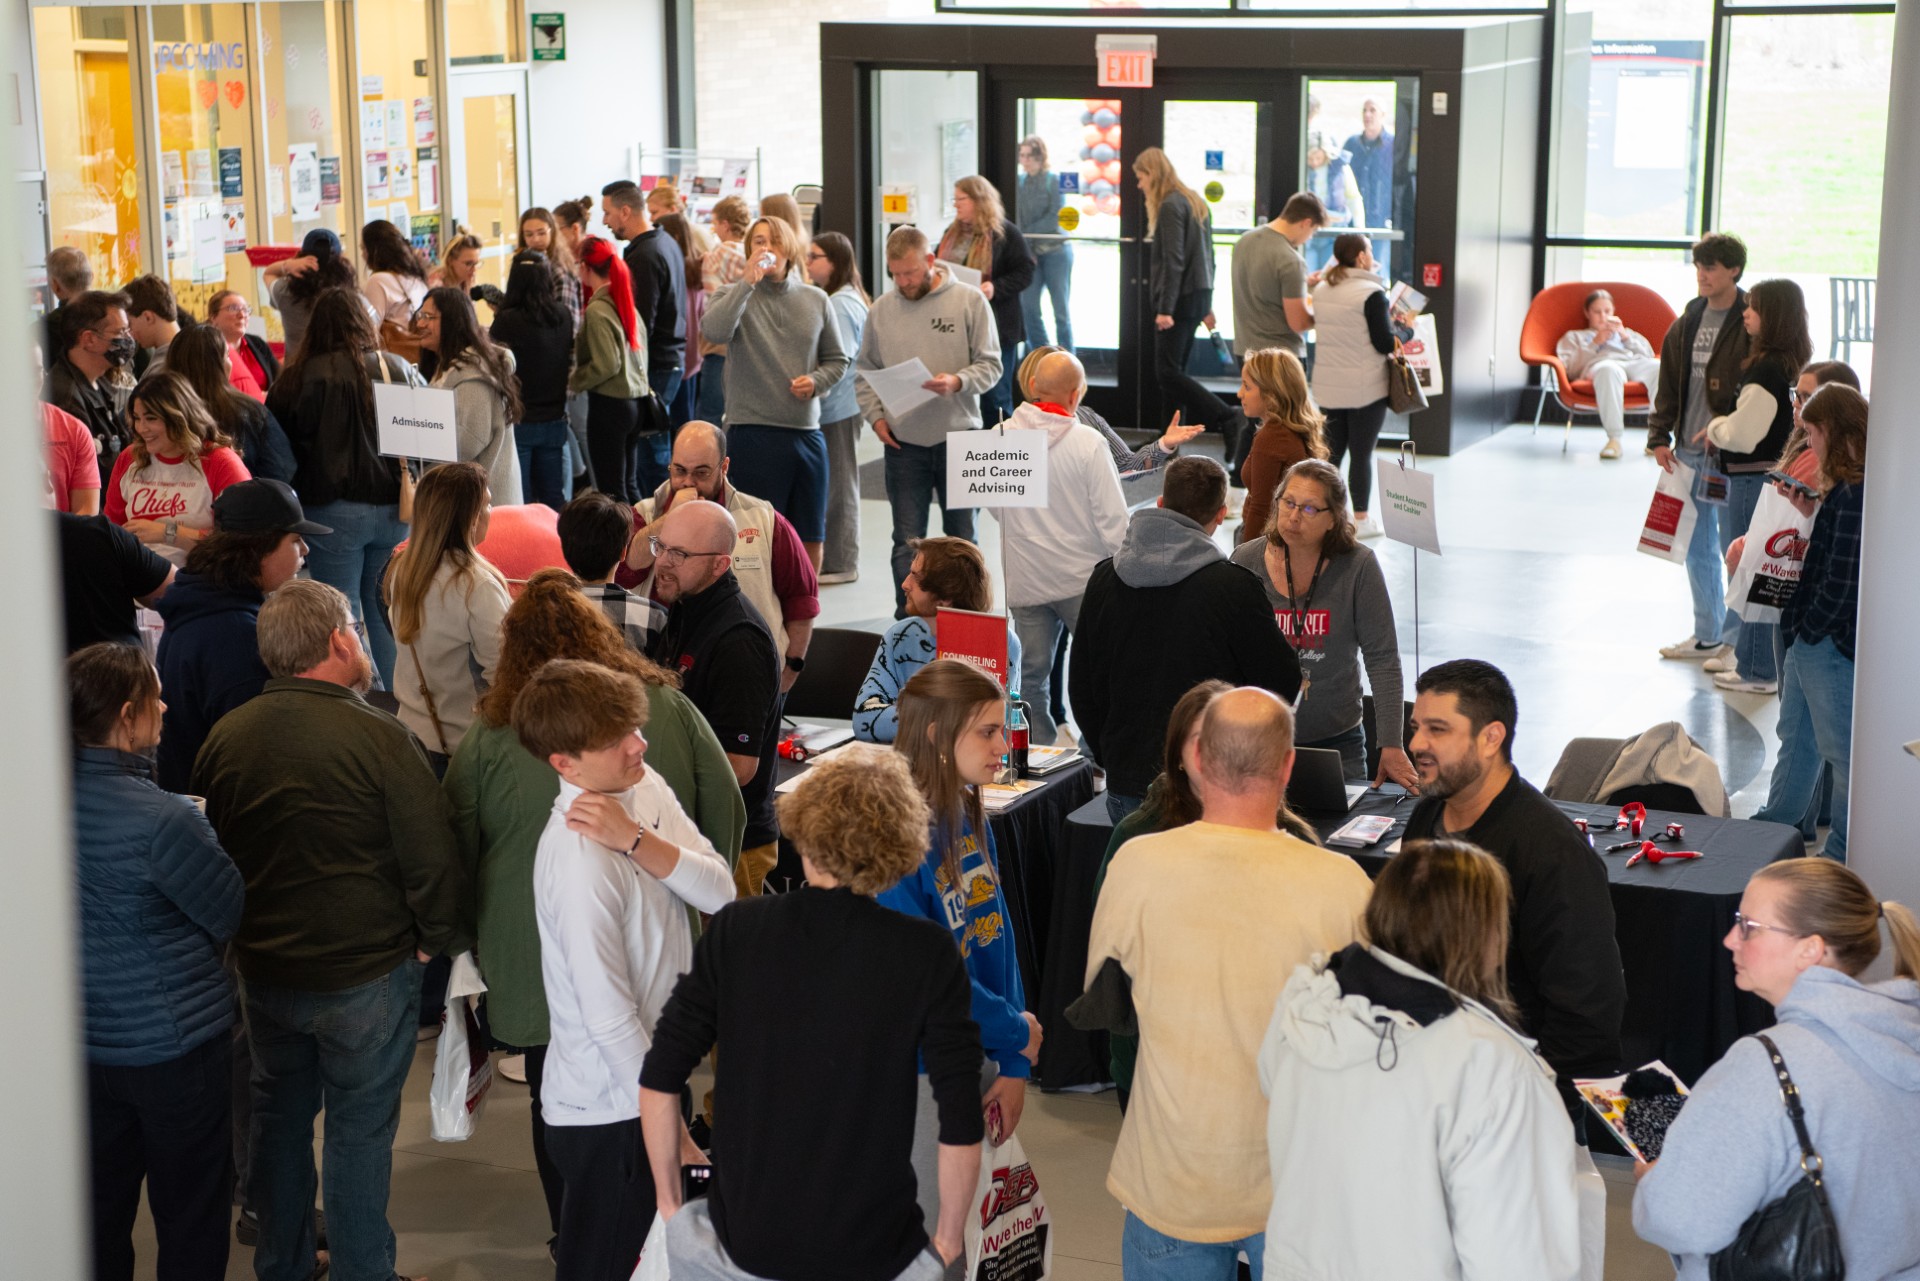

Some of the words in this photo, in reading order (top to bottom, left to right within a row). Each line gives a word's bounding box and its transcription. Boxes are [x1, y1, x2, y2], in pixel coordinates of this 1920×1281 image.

[1106, 54, 1147, 82] EXIT
[391, 415, 445, 431] Admissions
[964, 449, 1030, 462] Academic
[961, 466, 986, 478] and
[989, 465, 1033, 478] Career
[968, 481, 1026, 496] Advising
[131, 487, 188, 518] Chiefs
[1385, 488, 1406, 502] Student
[1405, 494, 1428, 510] Accounts
[1393, 502, 1403, 511] and
[1403, 503, 1422, 517] Cashier
[941, 651, 998, 669] COUNSELING
[1298, 648, 1327, 663] College
[1013, 1216, 1033, 1236] the
